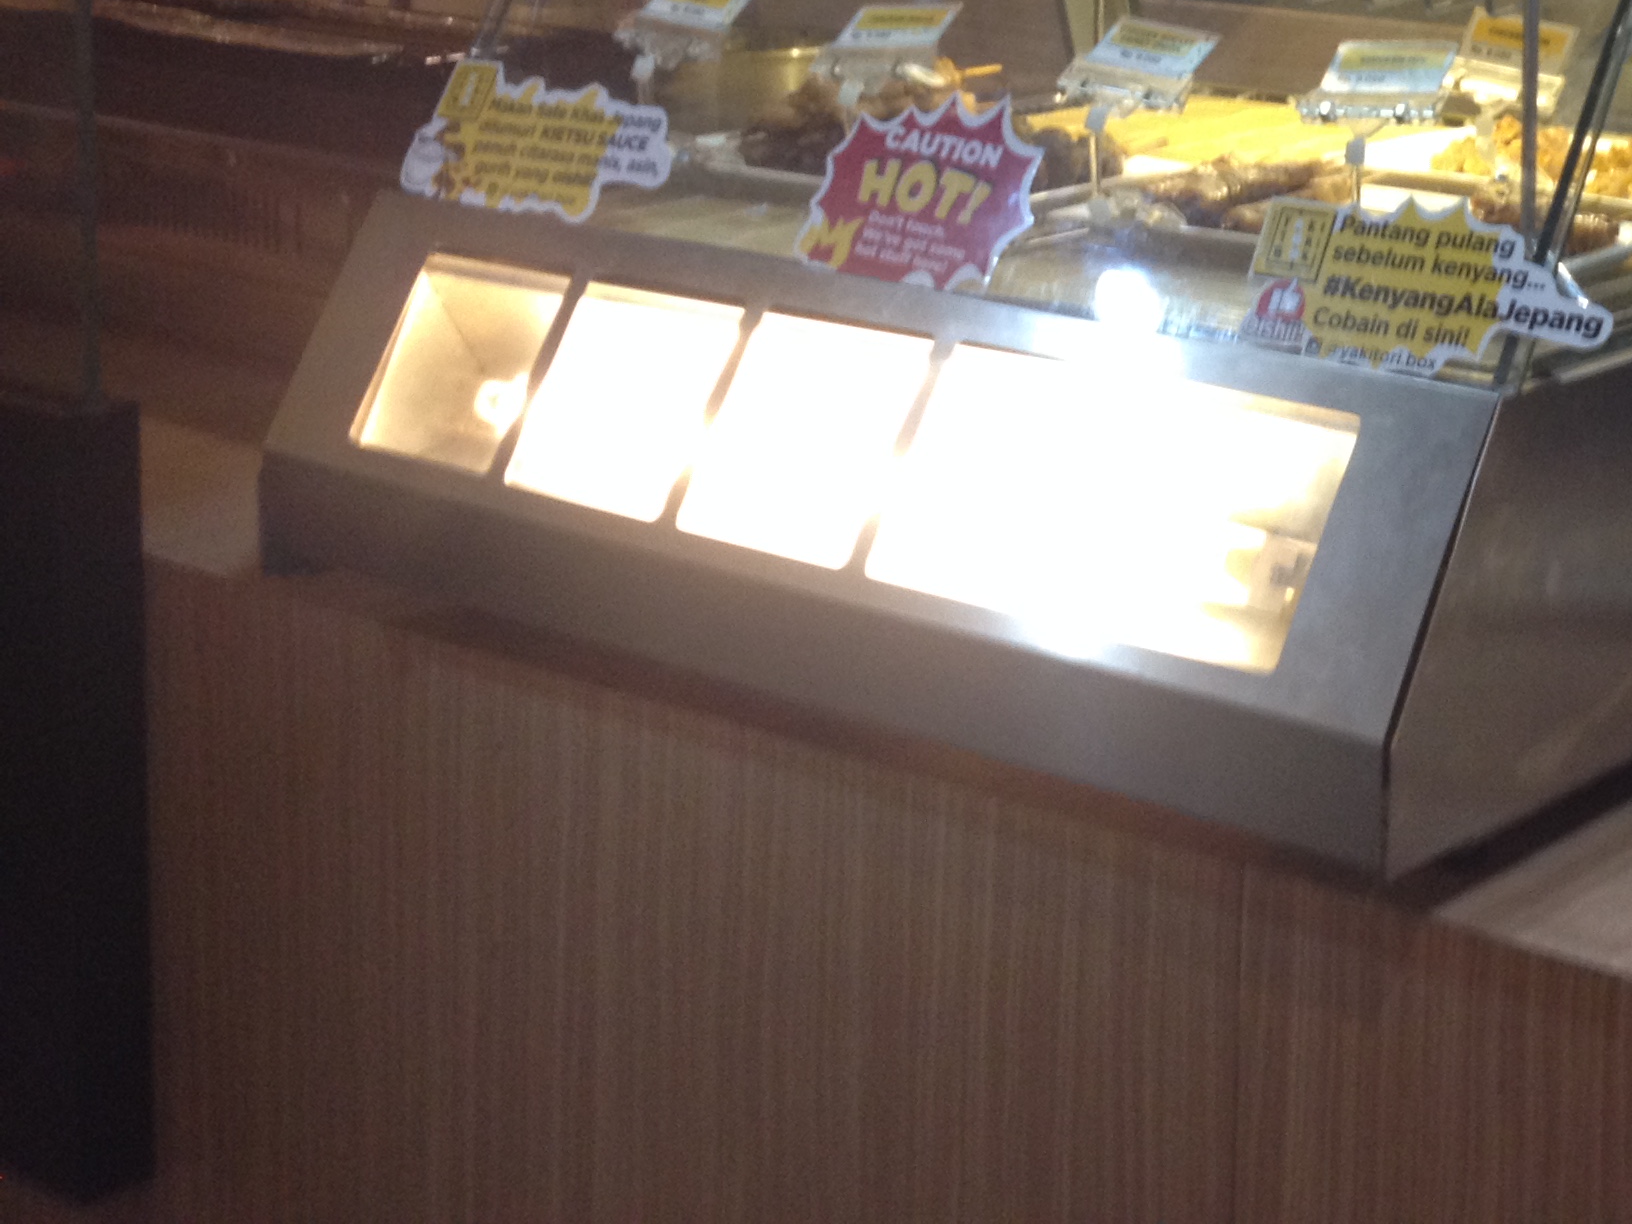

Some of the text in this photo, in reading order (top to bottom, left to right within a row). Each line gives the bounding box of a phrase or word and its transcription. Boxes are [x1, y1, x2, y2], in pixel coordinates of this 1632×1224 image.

[885, 126, 1004, 169] CAUTION
[857, 158, 993, 226] HOT!
[1332, 242, 1426, 272] sebelum
[1341, 213, 1516, 260] Pantang pulang
[1312, 306, 1390, 337] Cobain
[1395, 318, 1419, 341] di
